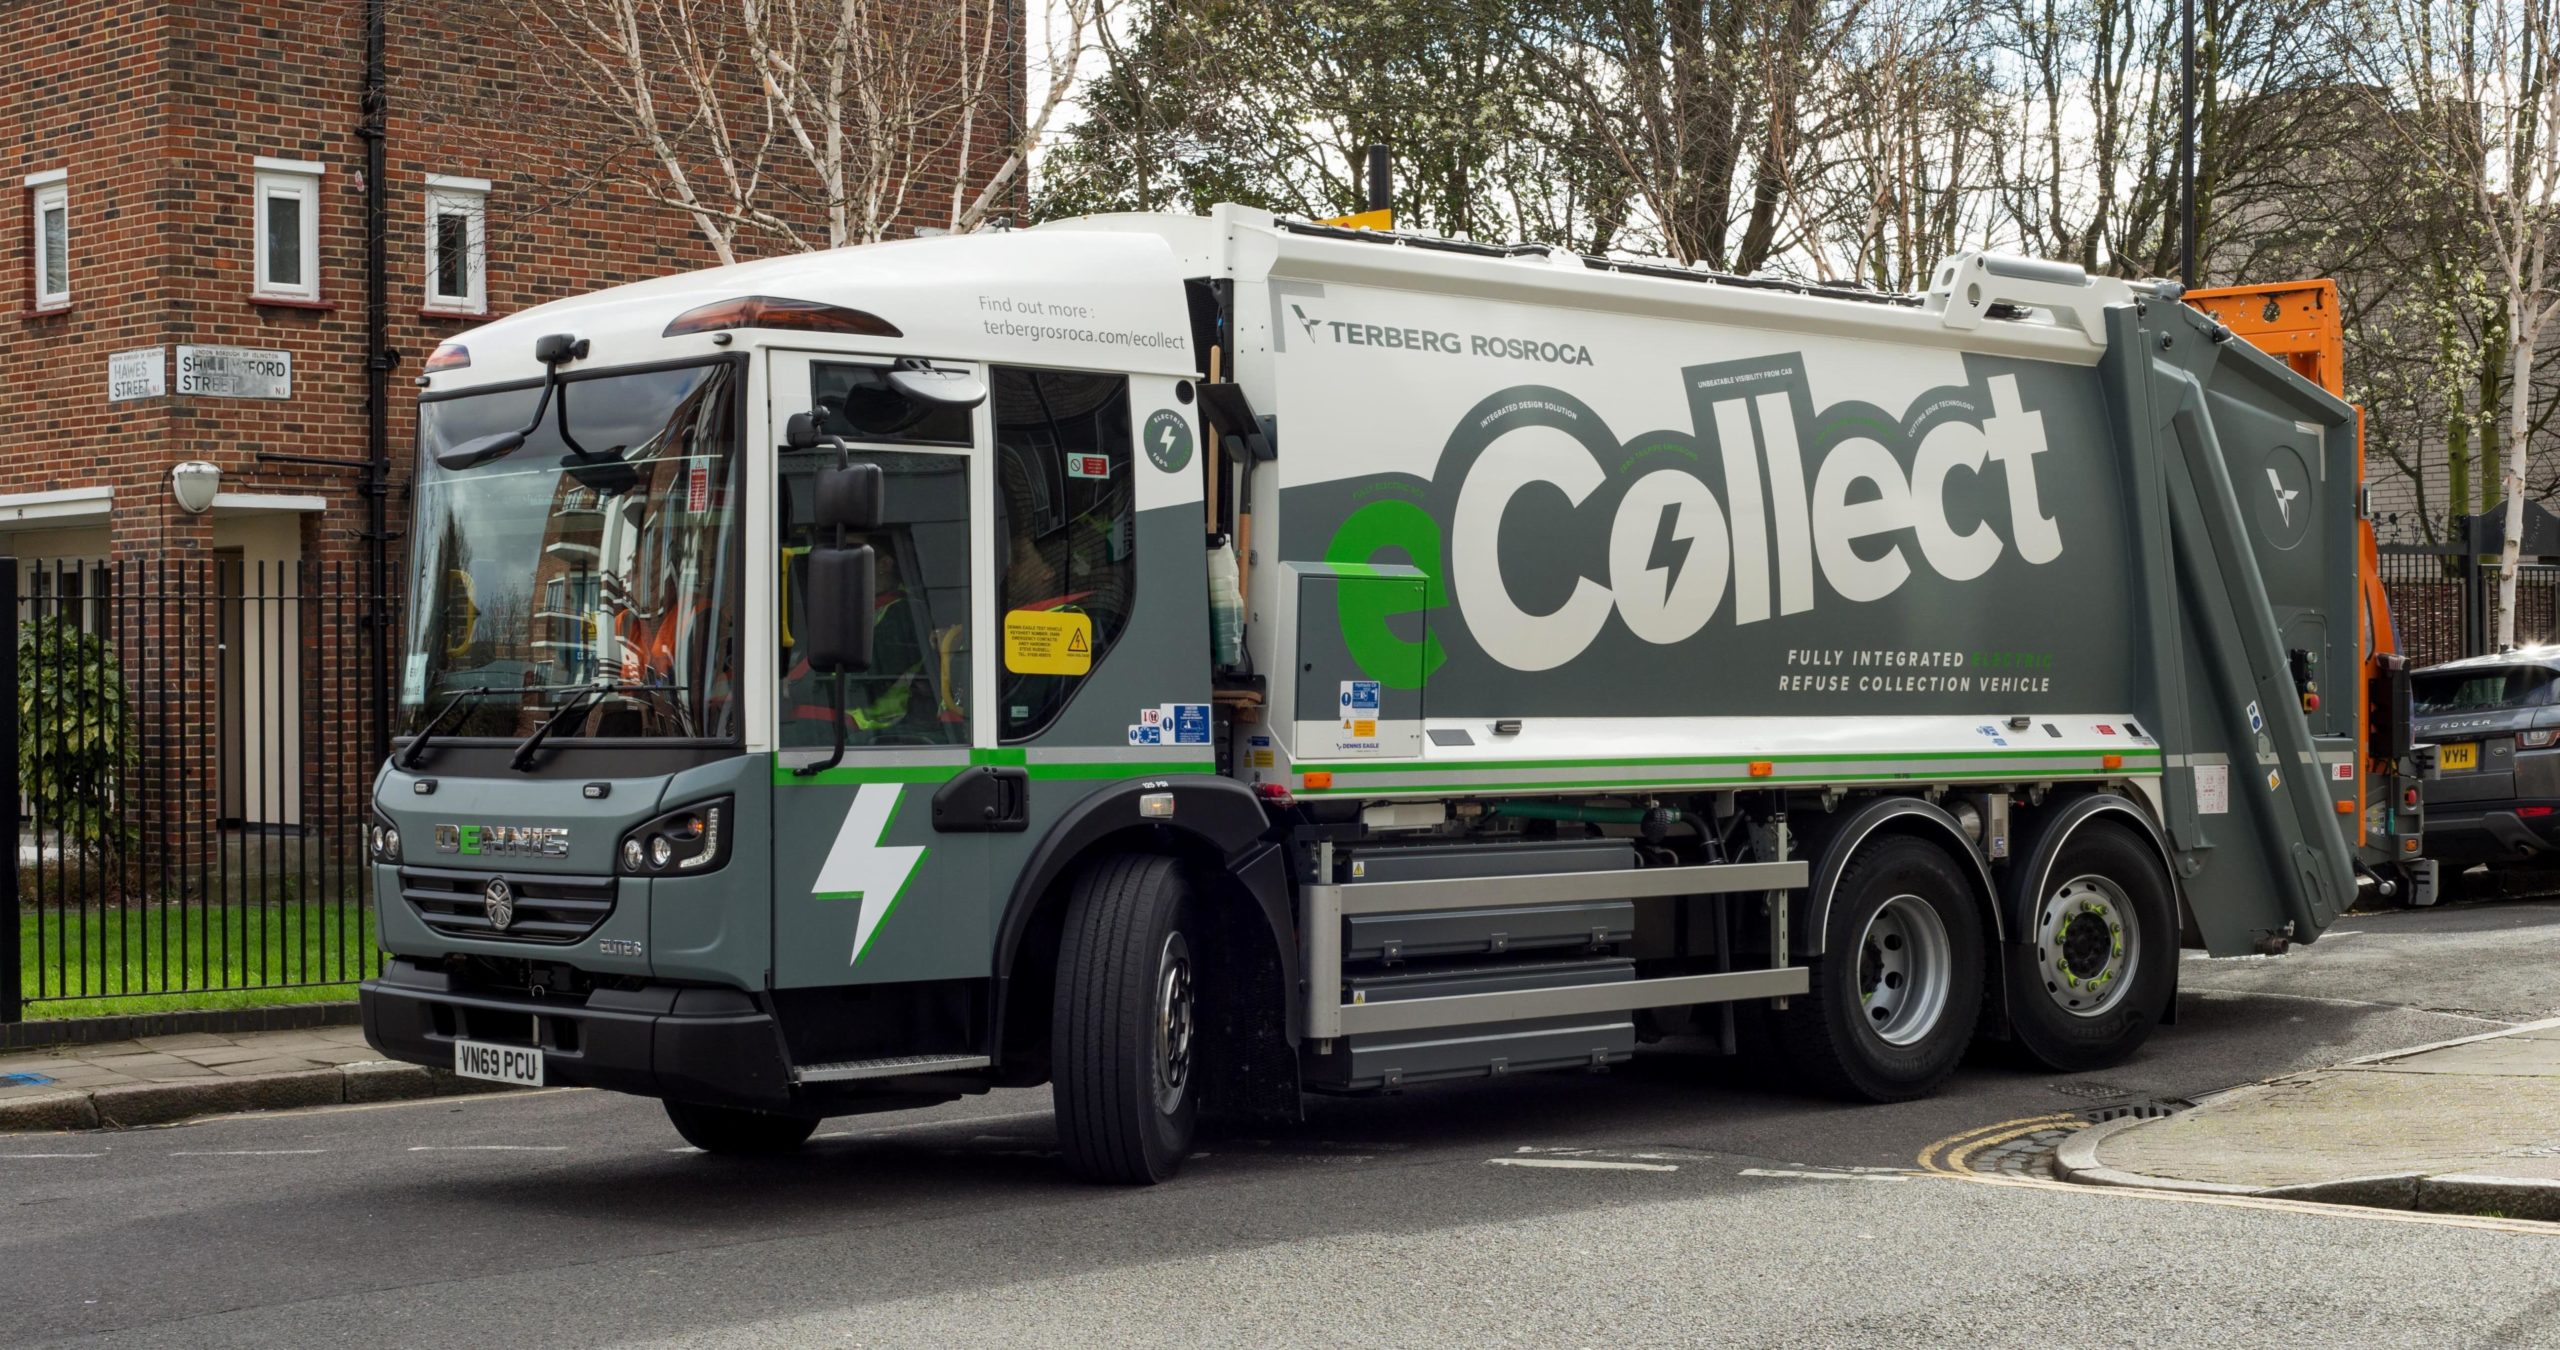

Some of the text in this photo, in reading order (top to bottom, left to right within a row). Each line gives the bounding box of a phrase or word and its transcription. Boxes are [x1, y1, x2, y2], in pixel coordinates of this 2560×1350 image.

[979, 296, 1012, 312] Find
[1017, 300, 1044, 315] out
[984, 319, 1185, 350] terbergrosroca.com/ecollect
[1327, 321, 1594, 366] TERBERG ROSROCA
[215, 350, 240, 358] BOROUGH
[251, 351, 279, 360] ISLINGTON
[114, 361, 147, 379] HAWES
[183, 356, 286, 377] SHILLINFORD
[183, 375, 239, 393] STREET
[1697, 367, 1793, 388] UNBEATABLE VISIBILITY FROM CAB
[115, 379, 149, 398] STREET
[1154, 413, 1184, 429] ELECTRIC
[1480, 400, 1578, 428] INTEGRATED DESIGN SOLUTION
[1908, 412, 1926, 438] CUTTING
[1925, 403, 1939, 416] EDGE
[1939, 400, 1975, 412] TECHNOLOGY
[1323, 373, 2063, 689] eCollect
[1788, 649, 2054, 669] FULLY INTEGRATED ELECTRIC
[1779, 675, 2050, 692] REFUSE COLLECTION VEHICLE
[2440, 719, 2491, 729] ROVER
[2444, 749, 2468, 764] VYH
[434, 823, 569, 859] DENNIS
[600, 939, 632, 956] ELITE
[461, 1045, 536, 1080] VN69 PCU
